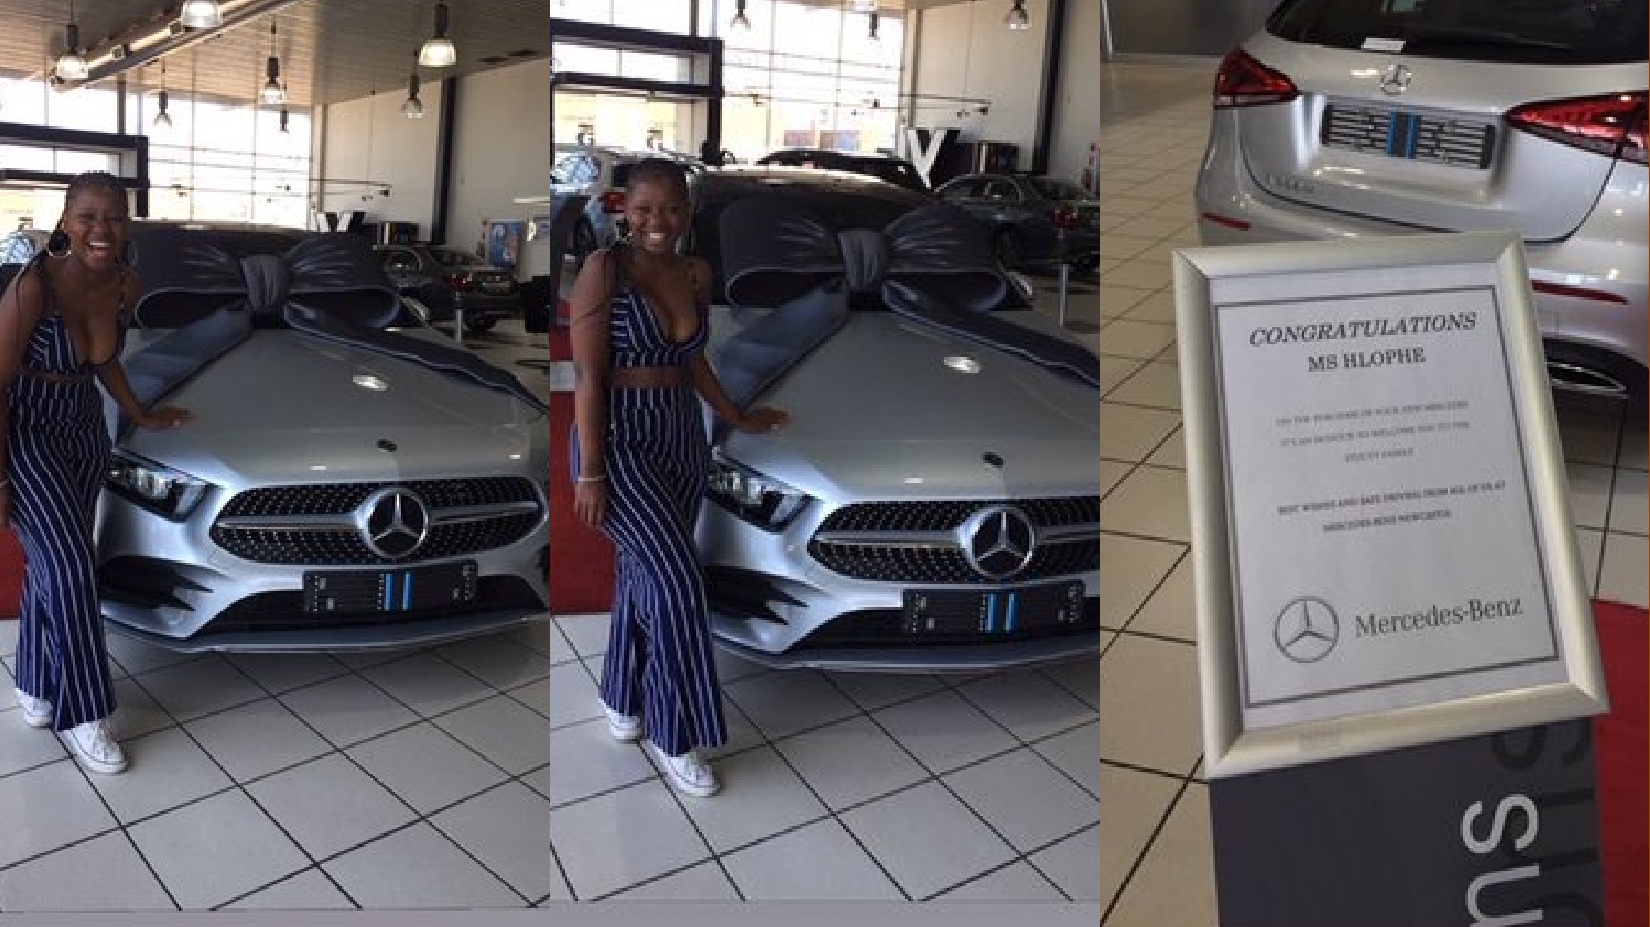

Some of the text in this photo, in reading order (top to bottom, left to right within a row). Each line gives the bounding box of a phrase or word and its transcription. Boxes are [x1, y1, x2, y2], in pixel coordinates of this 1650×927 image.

[1249, 311, 1478, 347] CONGRATULATIONS
[1308, 347, 1426, 372] MS HLOPHE
[1355, 598, 1523, 638] Mercedes-Benz
